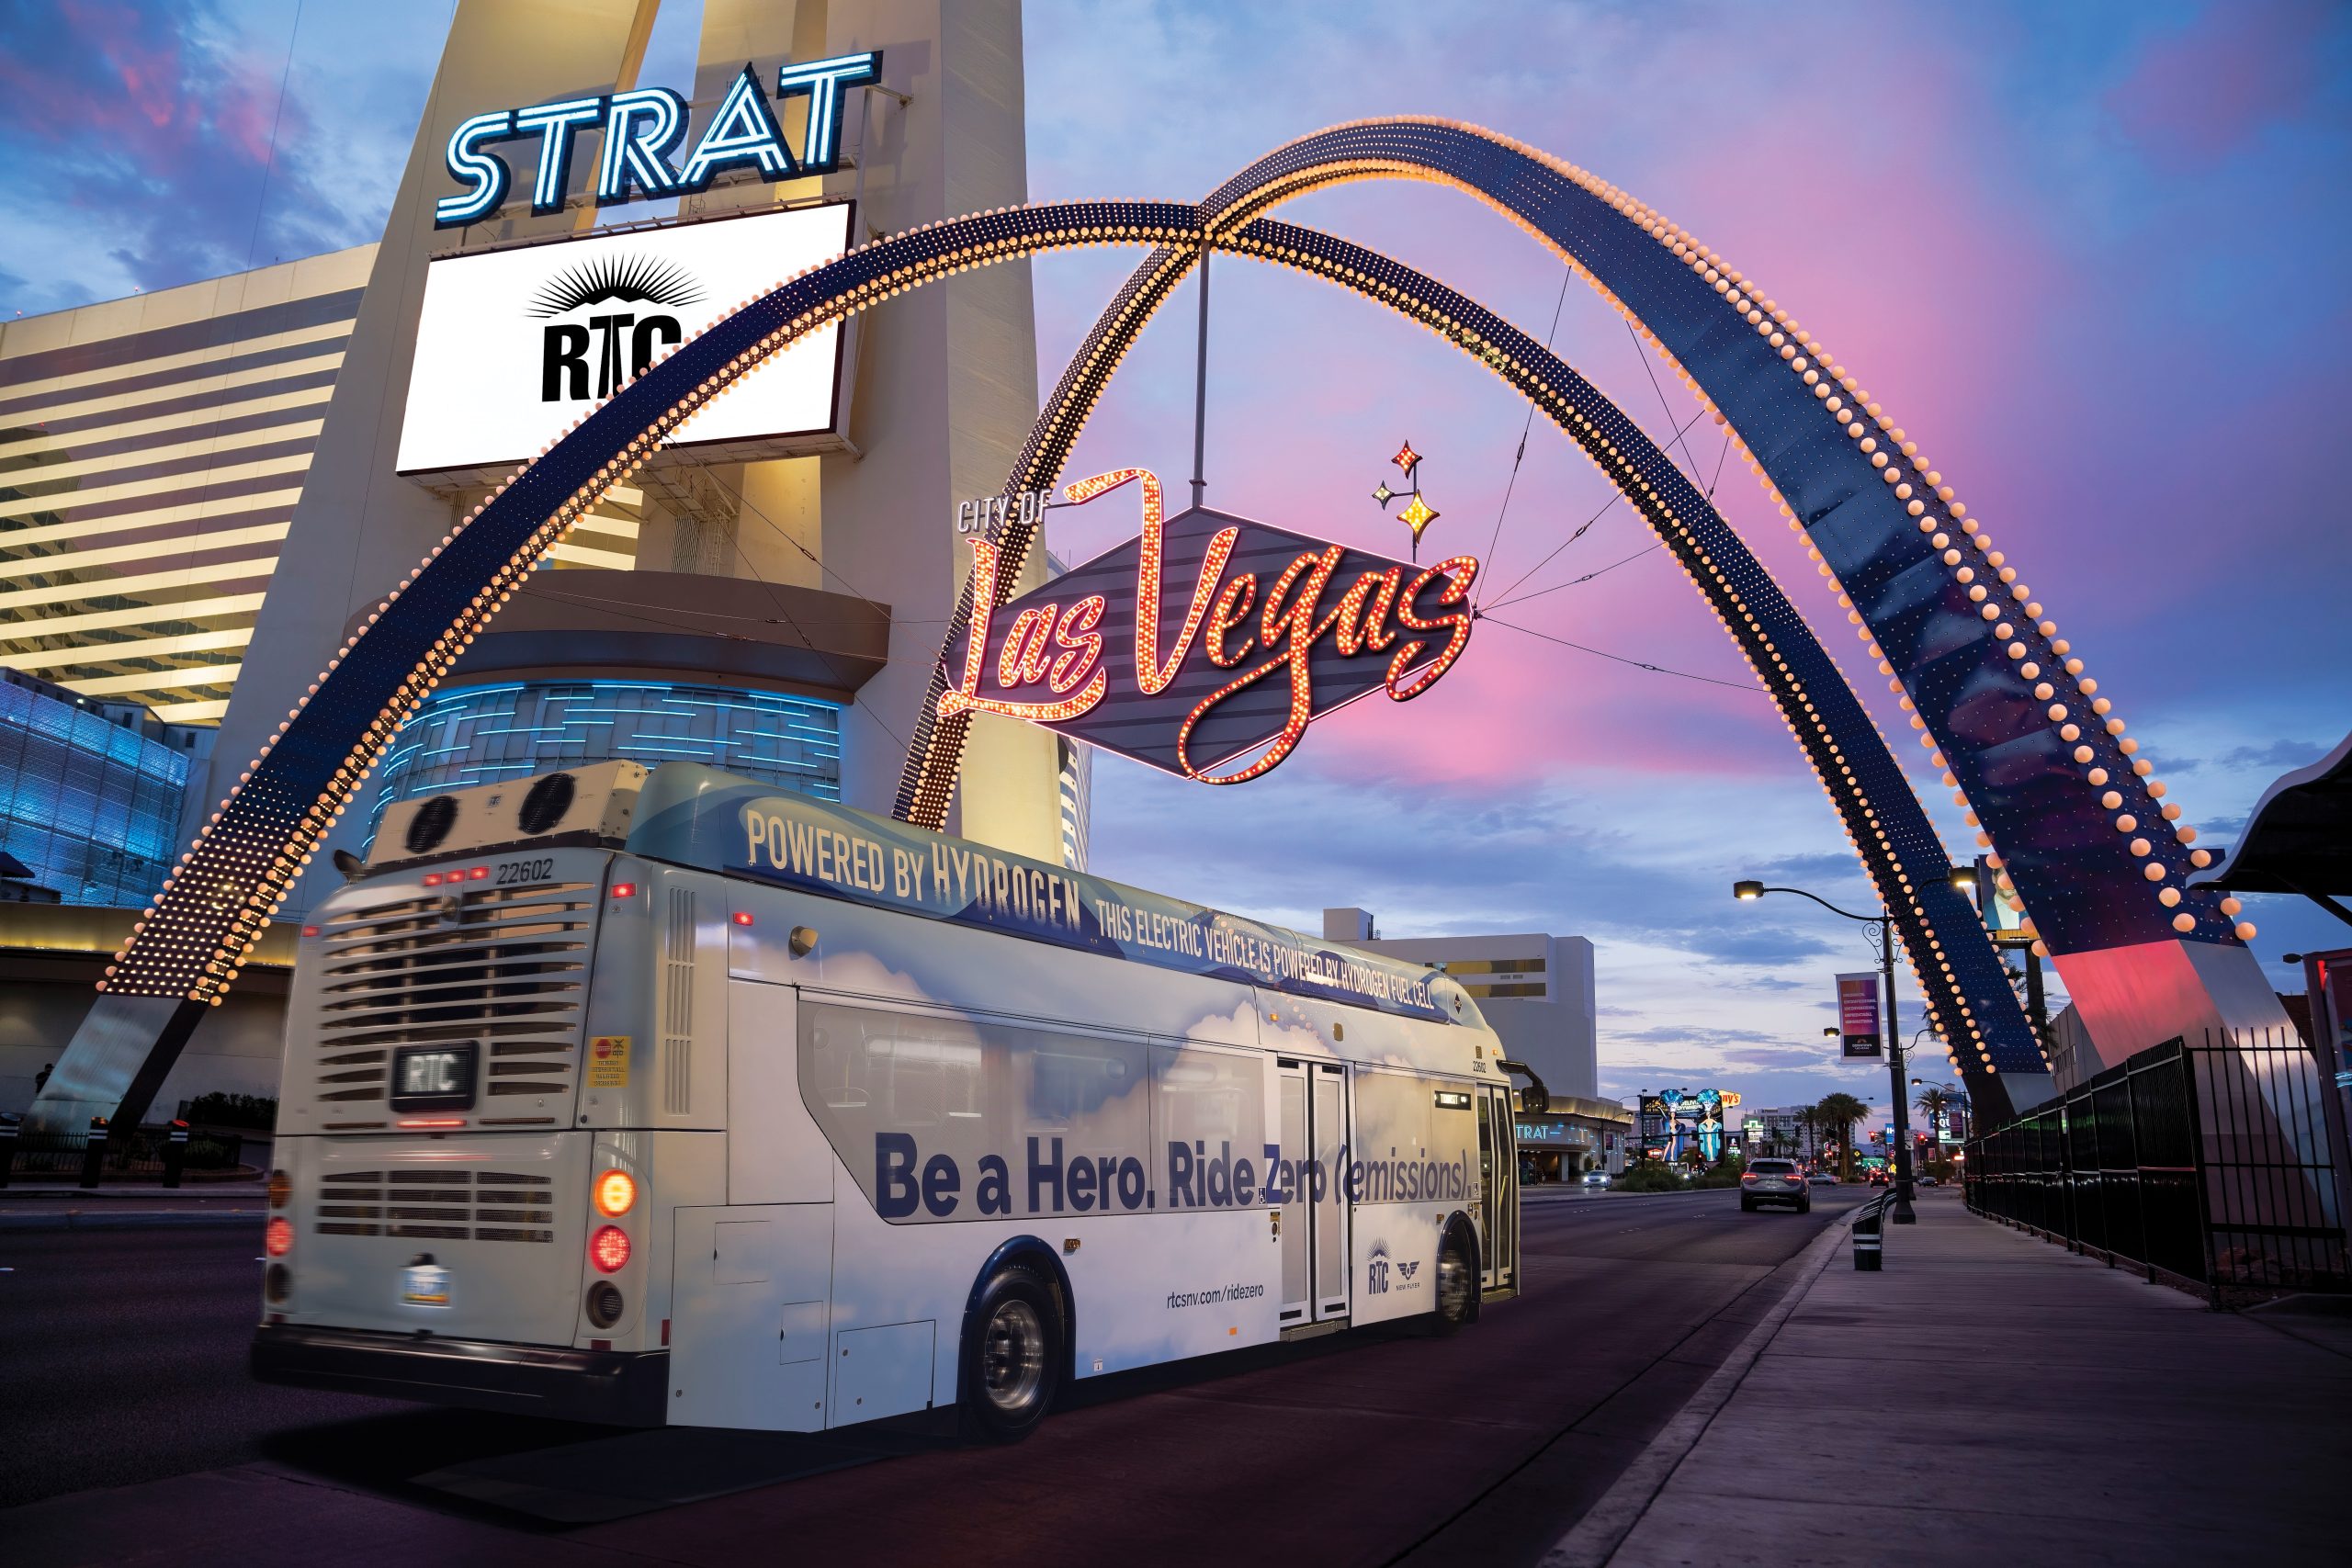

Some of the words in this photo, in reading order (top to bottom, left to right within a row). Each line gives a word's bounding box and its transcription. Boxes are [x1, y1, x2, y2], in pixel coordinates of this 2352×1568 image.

[435, 50, 883, 231] STRAT
[541, 312, 683, 402] RTC
[958, 496, 1010, 534] CITY
[1020, 489, 1052, 525] OF
[936, 537, 1107, 723] Las
[1063, 468, 1479, 786] Vegas
[496, 858, 554, 886] 22602
[747, 809, 886, 894] POWERED
[894, 848, 924, 902] BY
[932, 841, 1081, 934] HYDROGEN
[1095, 899, 1132, 942] THIS
[1135, 908, 1203, 957] ELECTRIC
[1204, 927, 1257, 969] VEHICLE
[1258, 940, 1272, 974] IS
[1273, 944, 1324, 984] POWERED
[1326, 957, 1339, 987] BY
[1340, 962, 1391, 999] HYDROGEN
[1391, 975, 1413, 1005] FUEL
[1413, 981, 1435, 1010] CELL
[407, 1054, 457, 1093] RTC
[1516, 1125, 1549, 1140] TRAT
[875, 1132, 961, 1218] Be
[976, 1154, 1012, 1215] a
[1027, 1136, 1156, 1213] Hero.
[1168, 1140, 1256, 1208] Ride
[1263, 1144, 1327, 1205] Zero
[1334, 1144, 1472, 1206] (emissions).
[1166, 1282, 1264, 1311] rtcsnv.com/ridezero
[1368, 1260, 1389, 1295] RTC
[1396, 1283, 1407, 1292] NEW
[1407, 1281, 1420, 1290] FLYER
